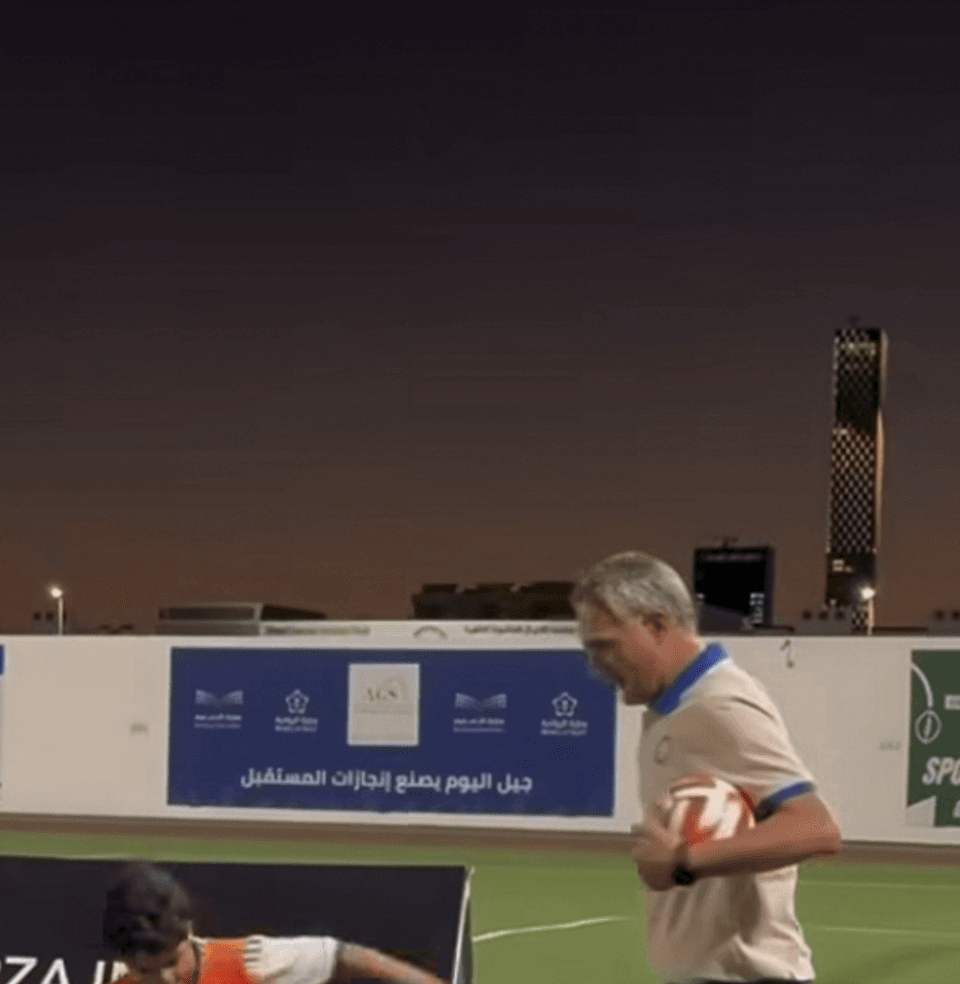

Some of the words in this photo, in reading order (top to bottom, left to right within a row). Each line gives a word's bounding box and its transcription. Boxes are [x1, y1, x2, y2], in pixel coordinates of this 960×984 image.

[240, 767, 327, 788] المستقبل
[331, 768, 392, 792] إنجازات
[395, 771, 442, 794] يصنع
[445, 773, 493, 795] اليوم
[496, 773, 533, 795] جيل
